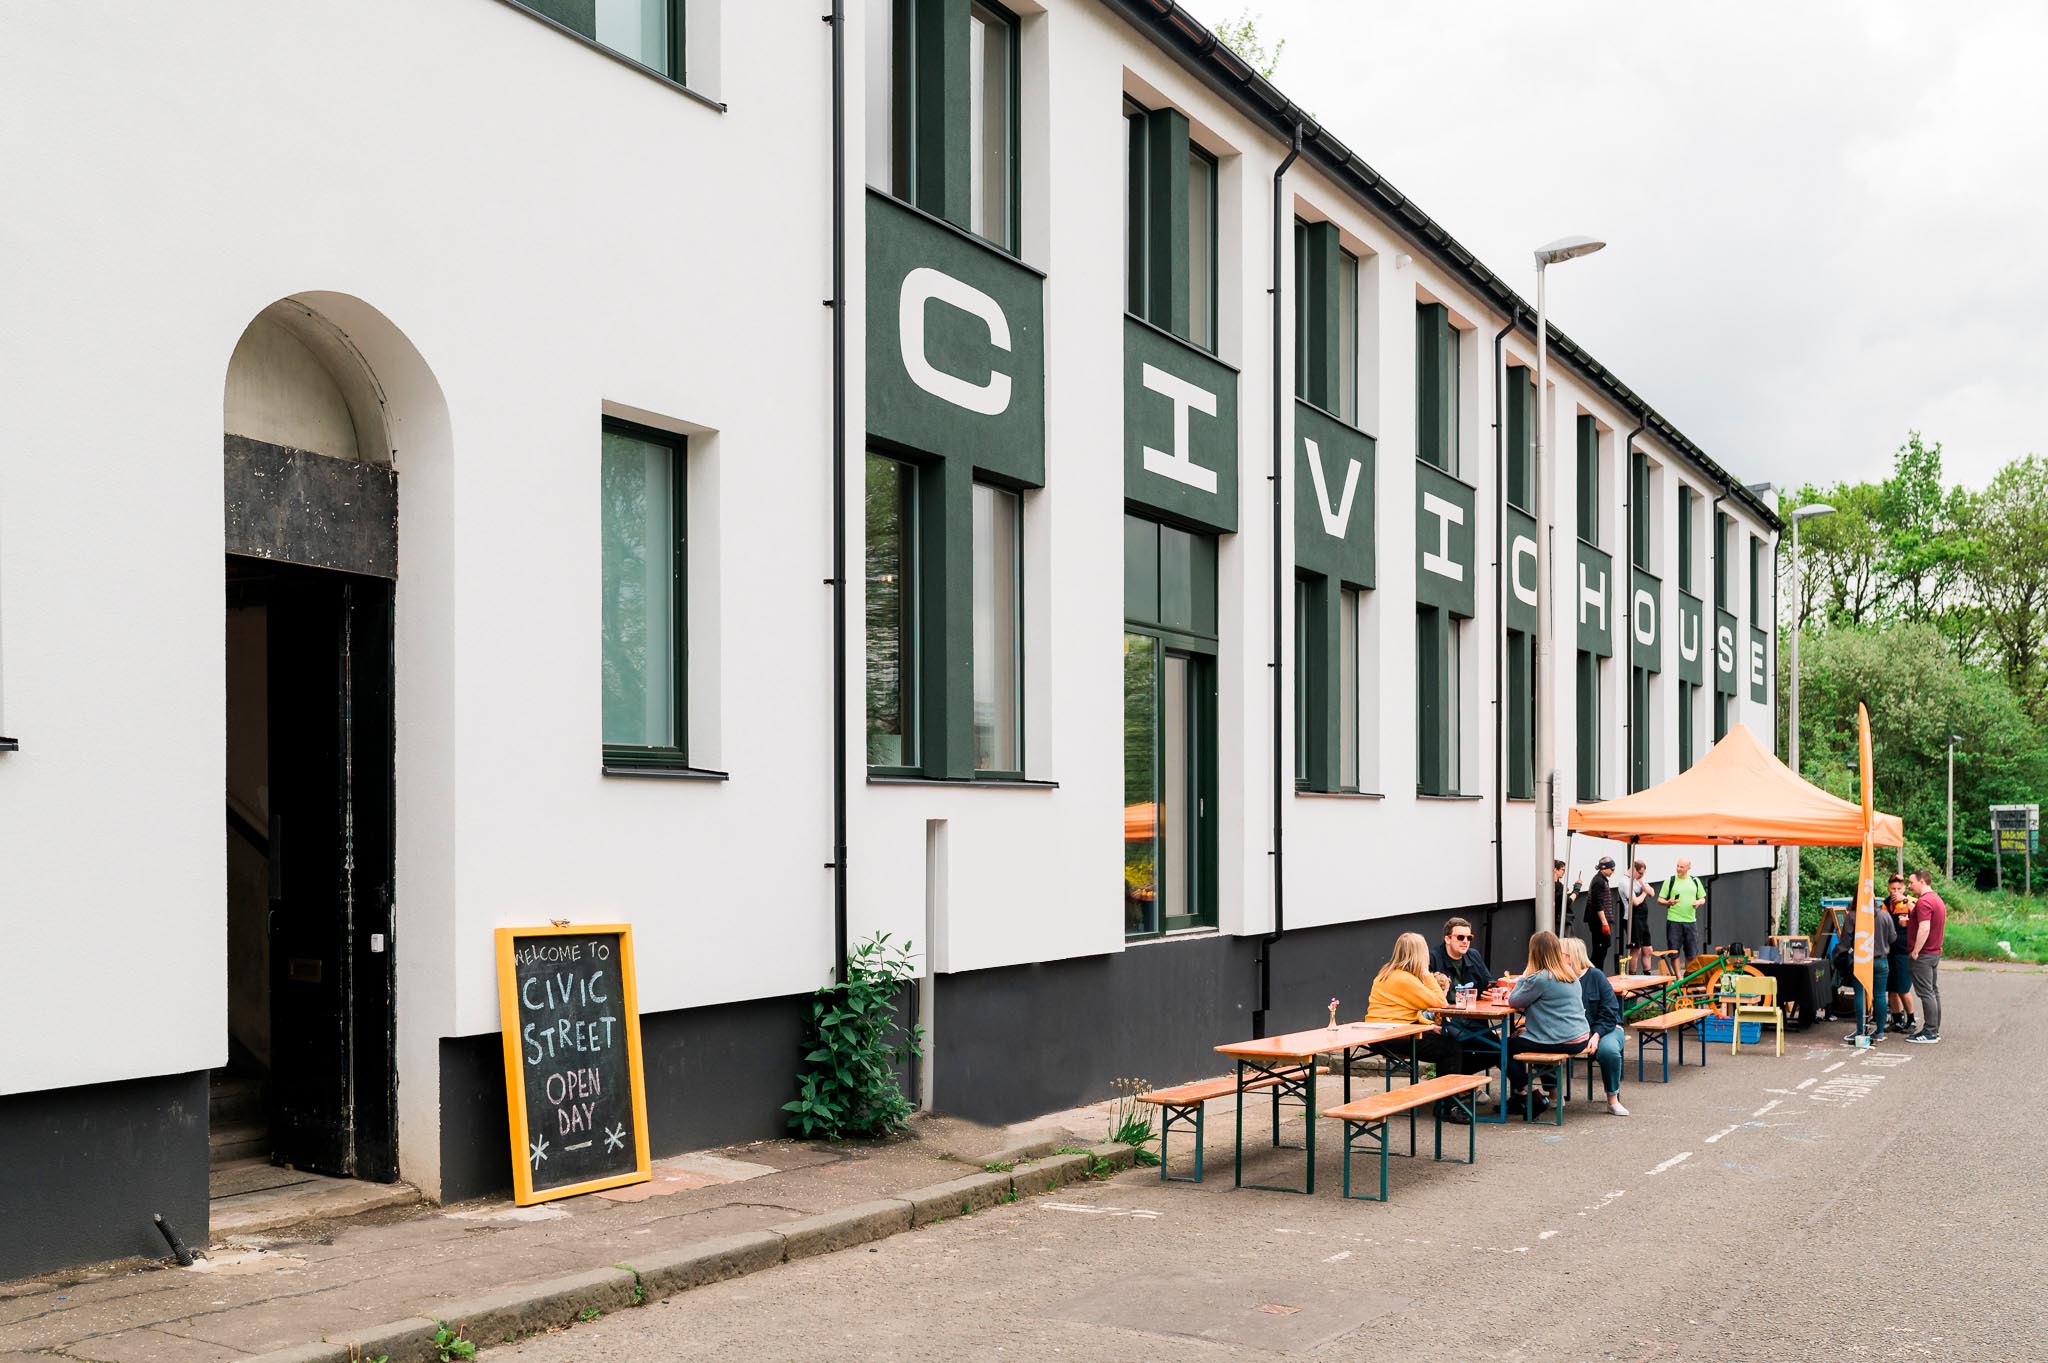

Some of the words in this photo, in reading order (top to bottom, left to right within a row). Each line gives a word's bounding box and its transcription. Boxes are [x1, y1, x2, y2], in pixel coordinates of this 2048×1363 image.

[1579, 562, 1763, 685] HOUSE
[515, 944, 581, 966] WELCOME
[588, 941, 610, 961] TO
[522, 970, 608, 1011] CIVIC
[524, 1016, 617, 1065] STREET
[546, 1067, 601, 1105] OPEN
[558, 1102, 596, 1136] DAY
